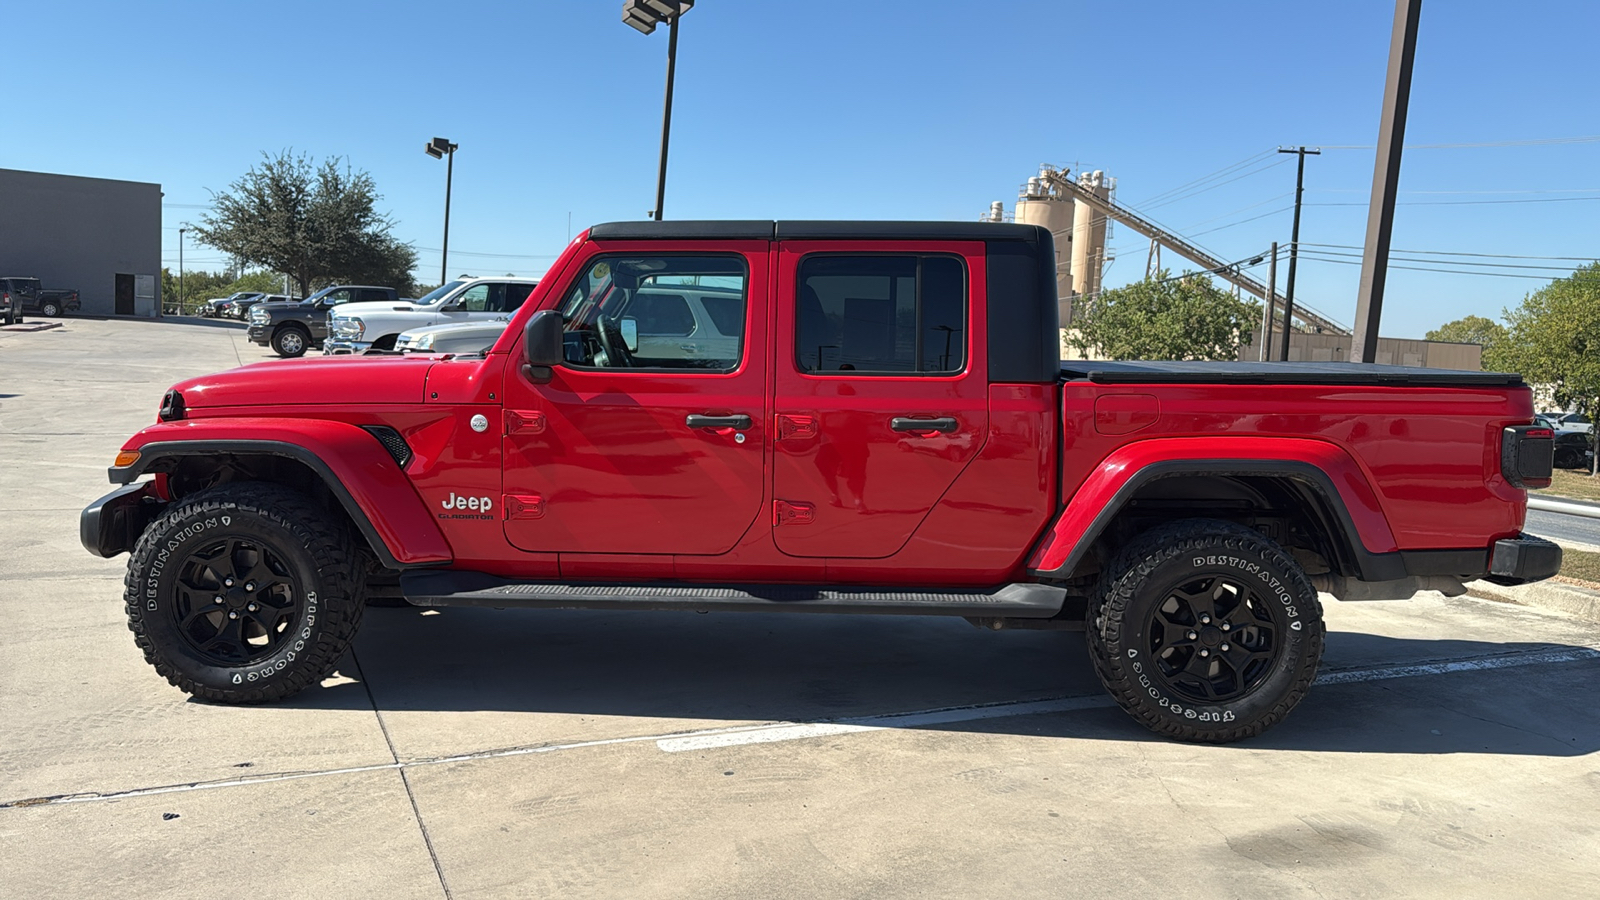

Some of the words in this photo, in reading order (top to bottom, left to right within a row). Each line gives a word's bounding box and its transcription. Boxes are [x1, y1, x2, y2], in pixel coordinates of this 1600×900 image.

[441, 492, 493, 513] Jeep
[147, 517, 218, 611] DESTINATION
[1193, 555, 1298, 618] DESTINATION
[246, 591, 318, 682] Firestone
[1132, 662, 1235, 722] Firestone
